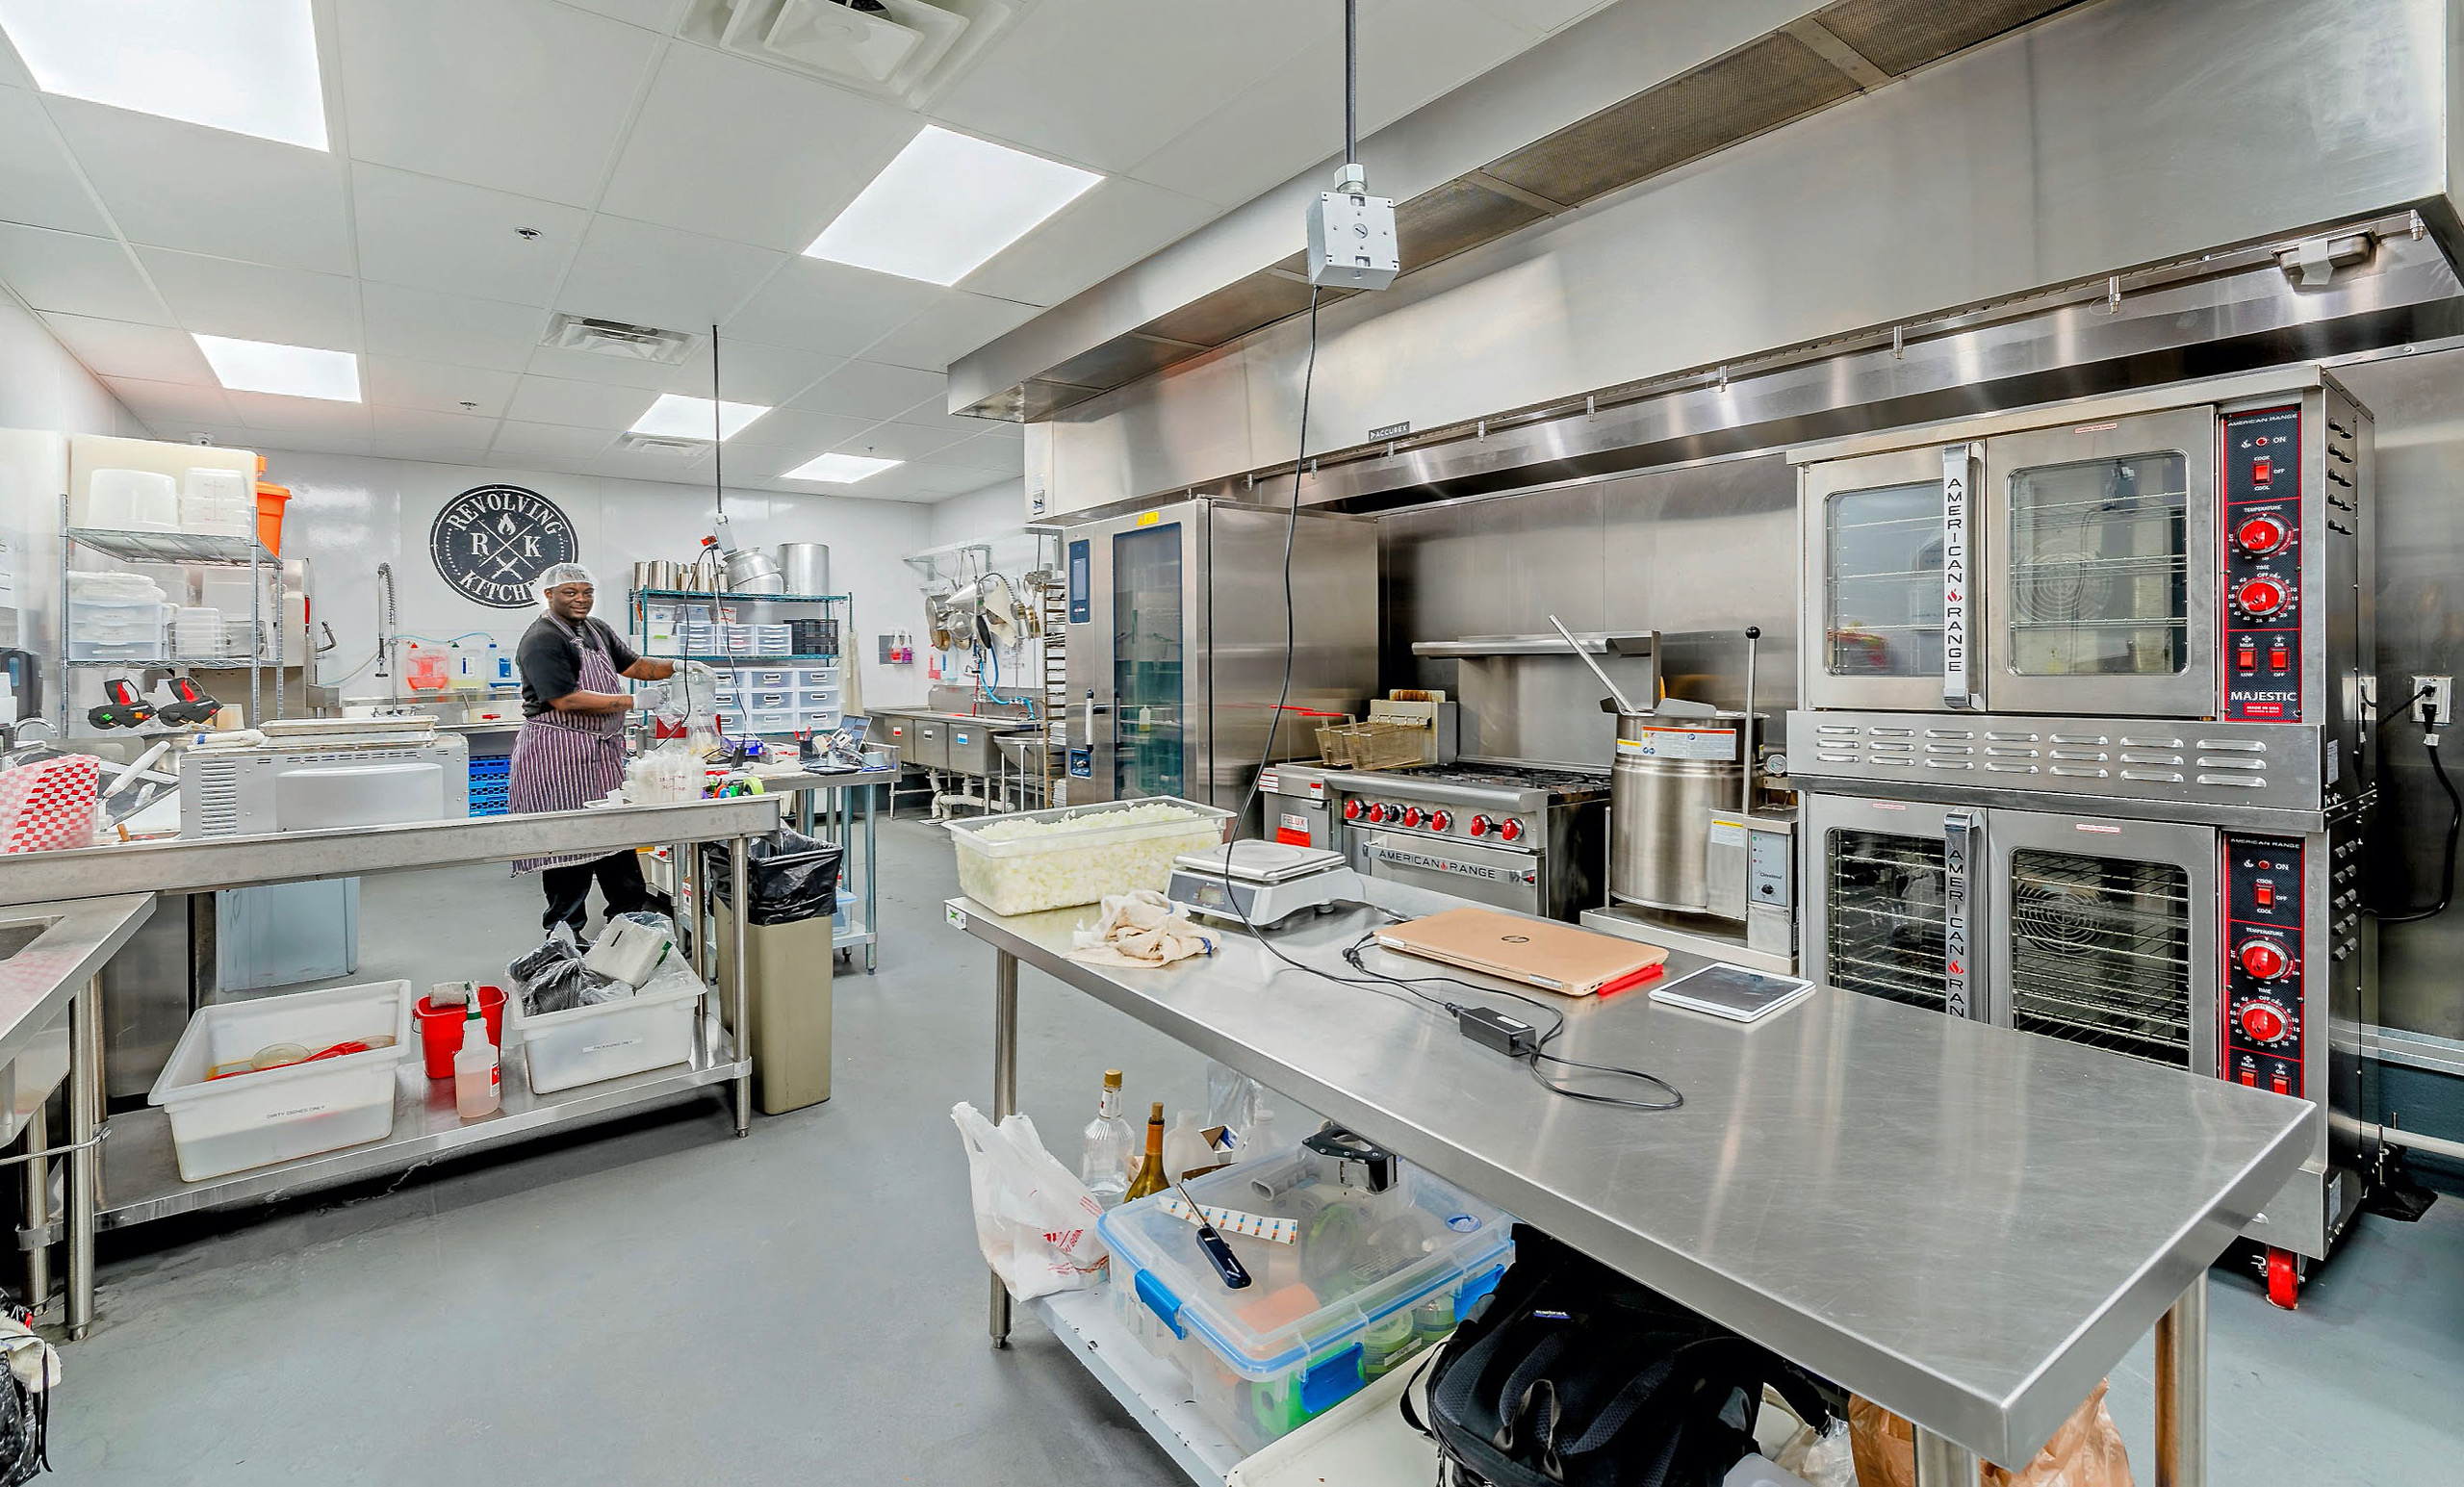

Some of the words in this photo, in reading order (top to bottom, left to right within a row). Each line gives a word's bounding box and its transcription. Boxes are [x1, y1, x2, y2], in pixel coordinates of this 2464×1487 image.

[2227, 418, 2268, 426] AMERICAN
[2269, 413, 2298, 422] RANGE
[446, 493, 565, 535] REVOLVING
[1947, 478, 1963, 583] AMERICAN
[470, 532, 489, 556] R
[523, 535, 542, 557] K
[459, 570, 537, 602] KITCH
[1947, 607, 1963, 672] RANGE
[2229, 691, 2297, 702] MAJESTIC
[2230, 837, 2271, 846] AMERICAN
[1378, 850, 1440, 869] AMERICAN
[1449, 862, 1496, 880] RANGE
[1759, 871, 1783, 881] Cleveland
[2274, 862, 2290, 871] ON
[1948, 849, 1964, 957] AMERICAN
[2246, 927, 2284, 936] TEMPERATURE
[1948, 978, 1964, 1018] RAN
